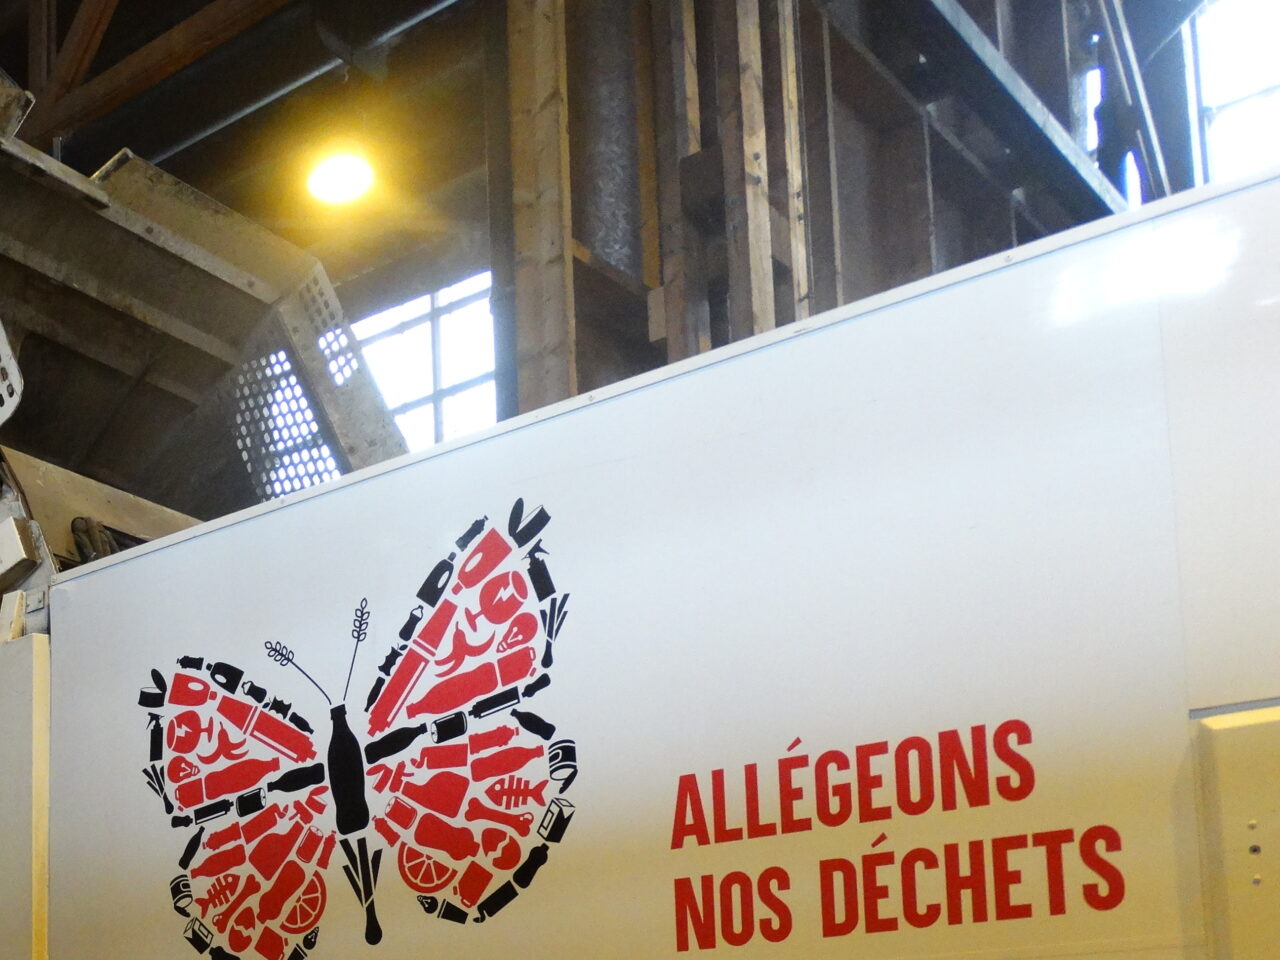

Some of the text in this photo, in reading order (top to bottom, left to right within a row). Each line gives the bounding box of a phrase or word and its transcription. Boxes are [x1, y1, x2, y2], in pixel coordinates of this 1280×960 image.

[670, 719, 1035, 850] ALLÉGEONS
[674, 825, 1125, 952] NOS DÉCHETS
